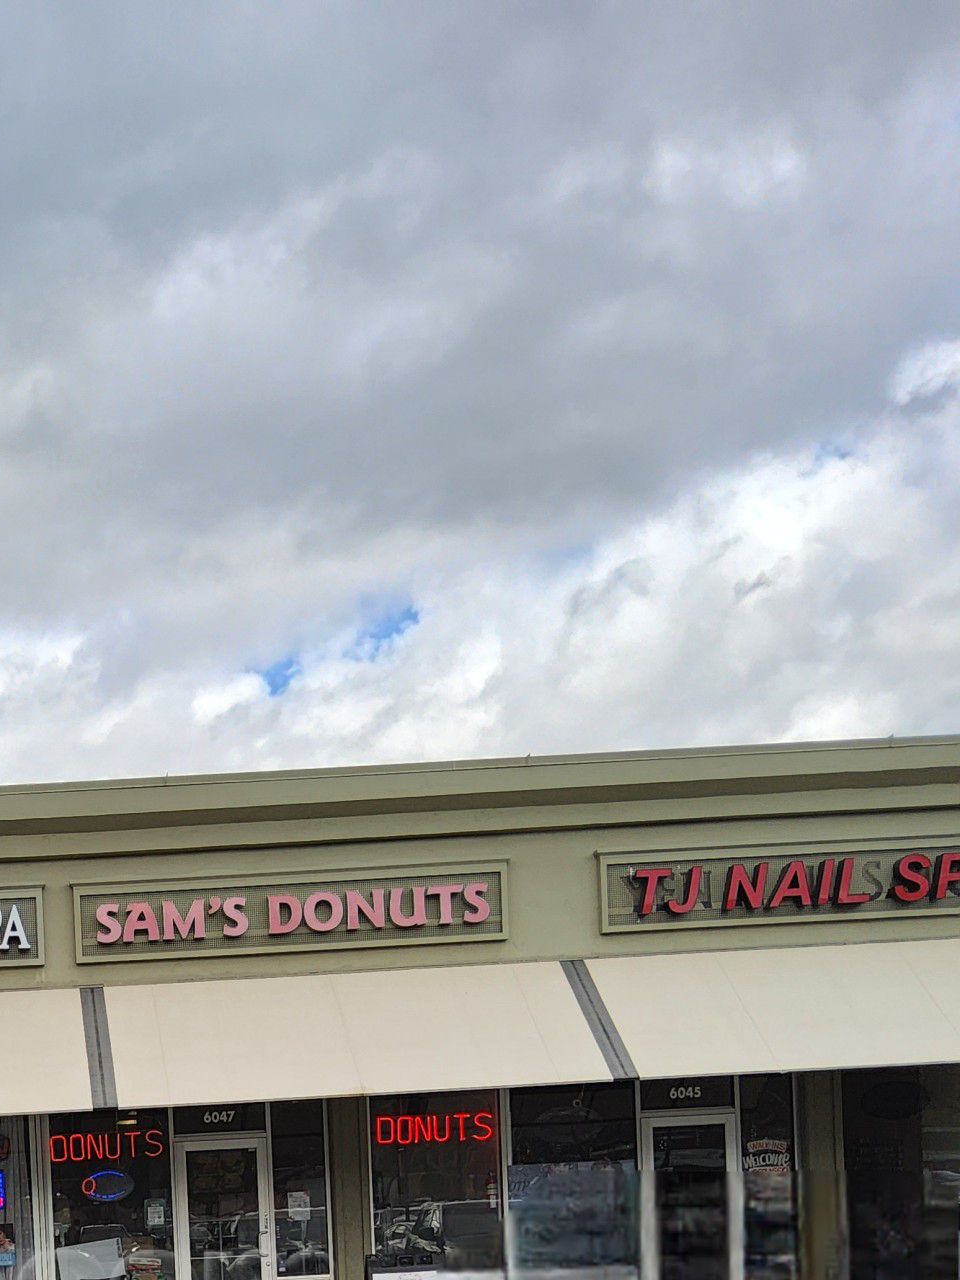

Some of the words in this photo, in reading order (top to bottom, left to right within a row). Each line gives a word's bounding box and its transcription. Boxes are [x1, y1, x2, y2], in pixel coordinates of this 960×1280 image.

[634, 866, 704, 915] TJ
[96, 896, 250, 945] SAM'S
[267, 881, 492, 936] DONUTS
[670, 1086, 701, 1099] 6045
[203, 1111, 235, 1123] 6047
[376, 1112, 493, 1144] DONUTS
[50, 1130, 163, 1162] DONUTS
